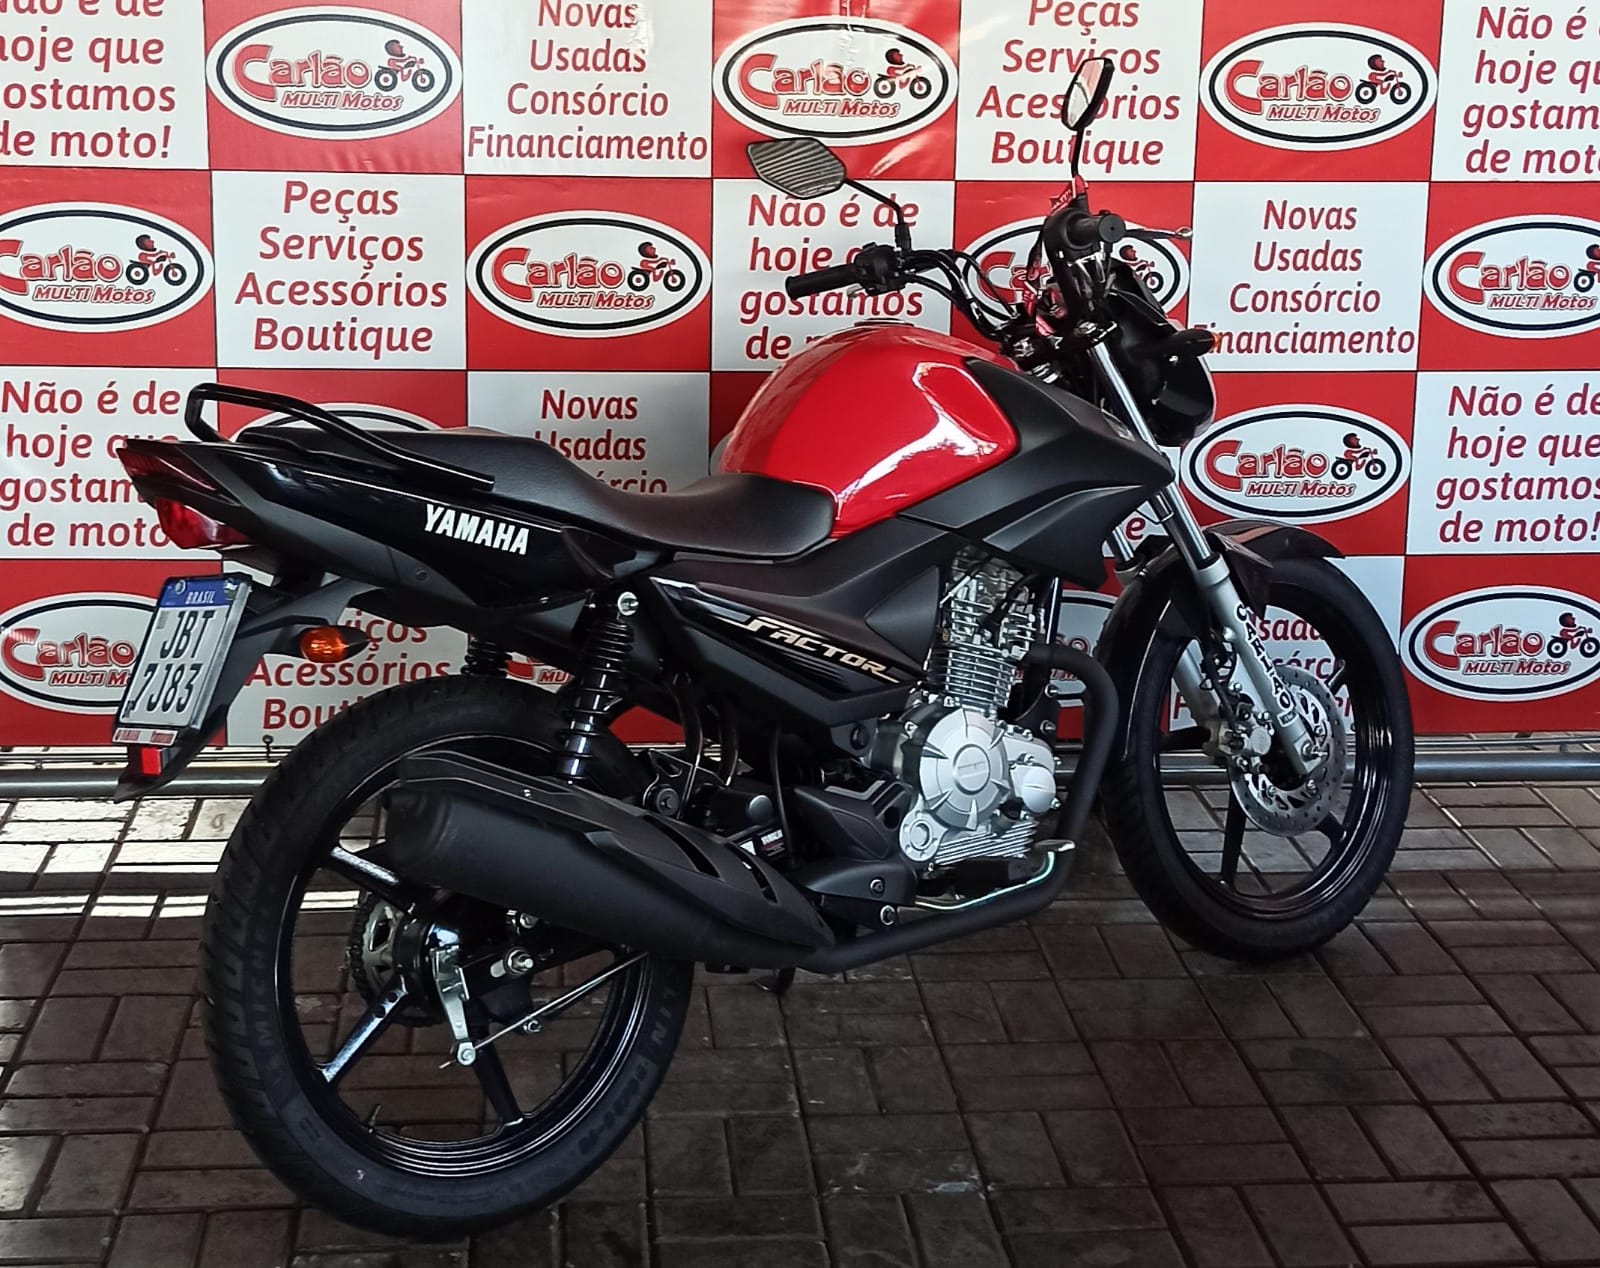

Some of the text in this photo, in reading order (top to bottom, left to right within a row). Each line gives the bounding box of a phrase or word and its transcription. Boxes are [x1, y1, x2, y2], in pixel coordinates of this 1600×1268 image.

[538, 0, 639, 28] Novas
[1028, 0, 1140, 36] Peças
[1476, 6, 1587, 40] Não é
[89, 37, 164, 73] que
[530, 38, 646, 72] Usadas
[1475, 49, 1557, 93] hoje
[233, 44, 373, 102] Carlão
[741, 53, 870, 110] Carlão
[1224, 60, 1353, 115] Carlão
[3, 79, 176, 112] ostamos
[281, 92, 405, 111] MULTI Motos
[507, 83, 669, 117] Consórcio
[783, 99, 901, 118] MULTI Motos
[1266, 104, 1380, 123] MULTI Motos
[1463, 100, 1600, 137] gostam
[51, 125, 171, 158] moto!
[467, 124, 708, 160] Financiamento
[991, 130, 1164, 173] Boutique
[1465, 139, 1600, 174] de mot
[283, 180, 399, 224] Peças
[748, 193, 919, 227] Não é de
[1263, 200, 1357, 230] Novas
[259, 225, 424, 270] Serviços
[749, 237, 833, 274] hoje
[1253, 240, 1363, 272] Usadas
[234, 272, 448, 307] Acessórios
[493, 248, 627, 301] Carlão
[1447, 251, 1571, 304] Carlão
[33, 284, 155, 305] MULTI Motos
[537, 291, 654, 311] MULTI Motos
[1230, 281, 1381, 313] Consórcio
[1487, 293, 1598, 311] MULTI Motos
[254, 317, 433, 360] Boutique
[746, 326, 792, 359] de
[1, 380, 181, 415] Não é de
[541, 389, 638, 420] Novas
[1448, 385, 1523, 416] Não
[1534, 384, 1555, 416] é
[6, 424, 93, 467] hoje
[1447, 426, 1600, 467] hoje que
[1203, 439, 1329, 493] Carlão
[1244, 481, 1357, 498] MULTI Motos
[7, 512, 55, 546] de
[424, 503, 530, 555] YAMAHA
[1439, 511, 1600, 543] de moto!
[185, 591, 216, 604] BRASIL
[160, 610, 216, 659] JBT
[735, 616, 900, 684] FACTOR
[1423, 620, 1545, 670] Carlão
[2, 628, 136, 680] Carlão
[245, 653, 451, 687] Acessórios
[1462, 659, 1571, 676] MULTI Motos
[49, 670, 105, 687] MULTI
[130, 663, 203, 713] 7J83
